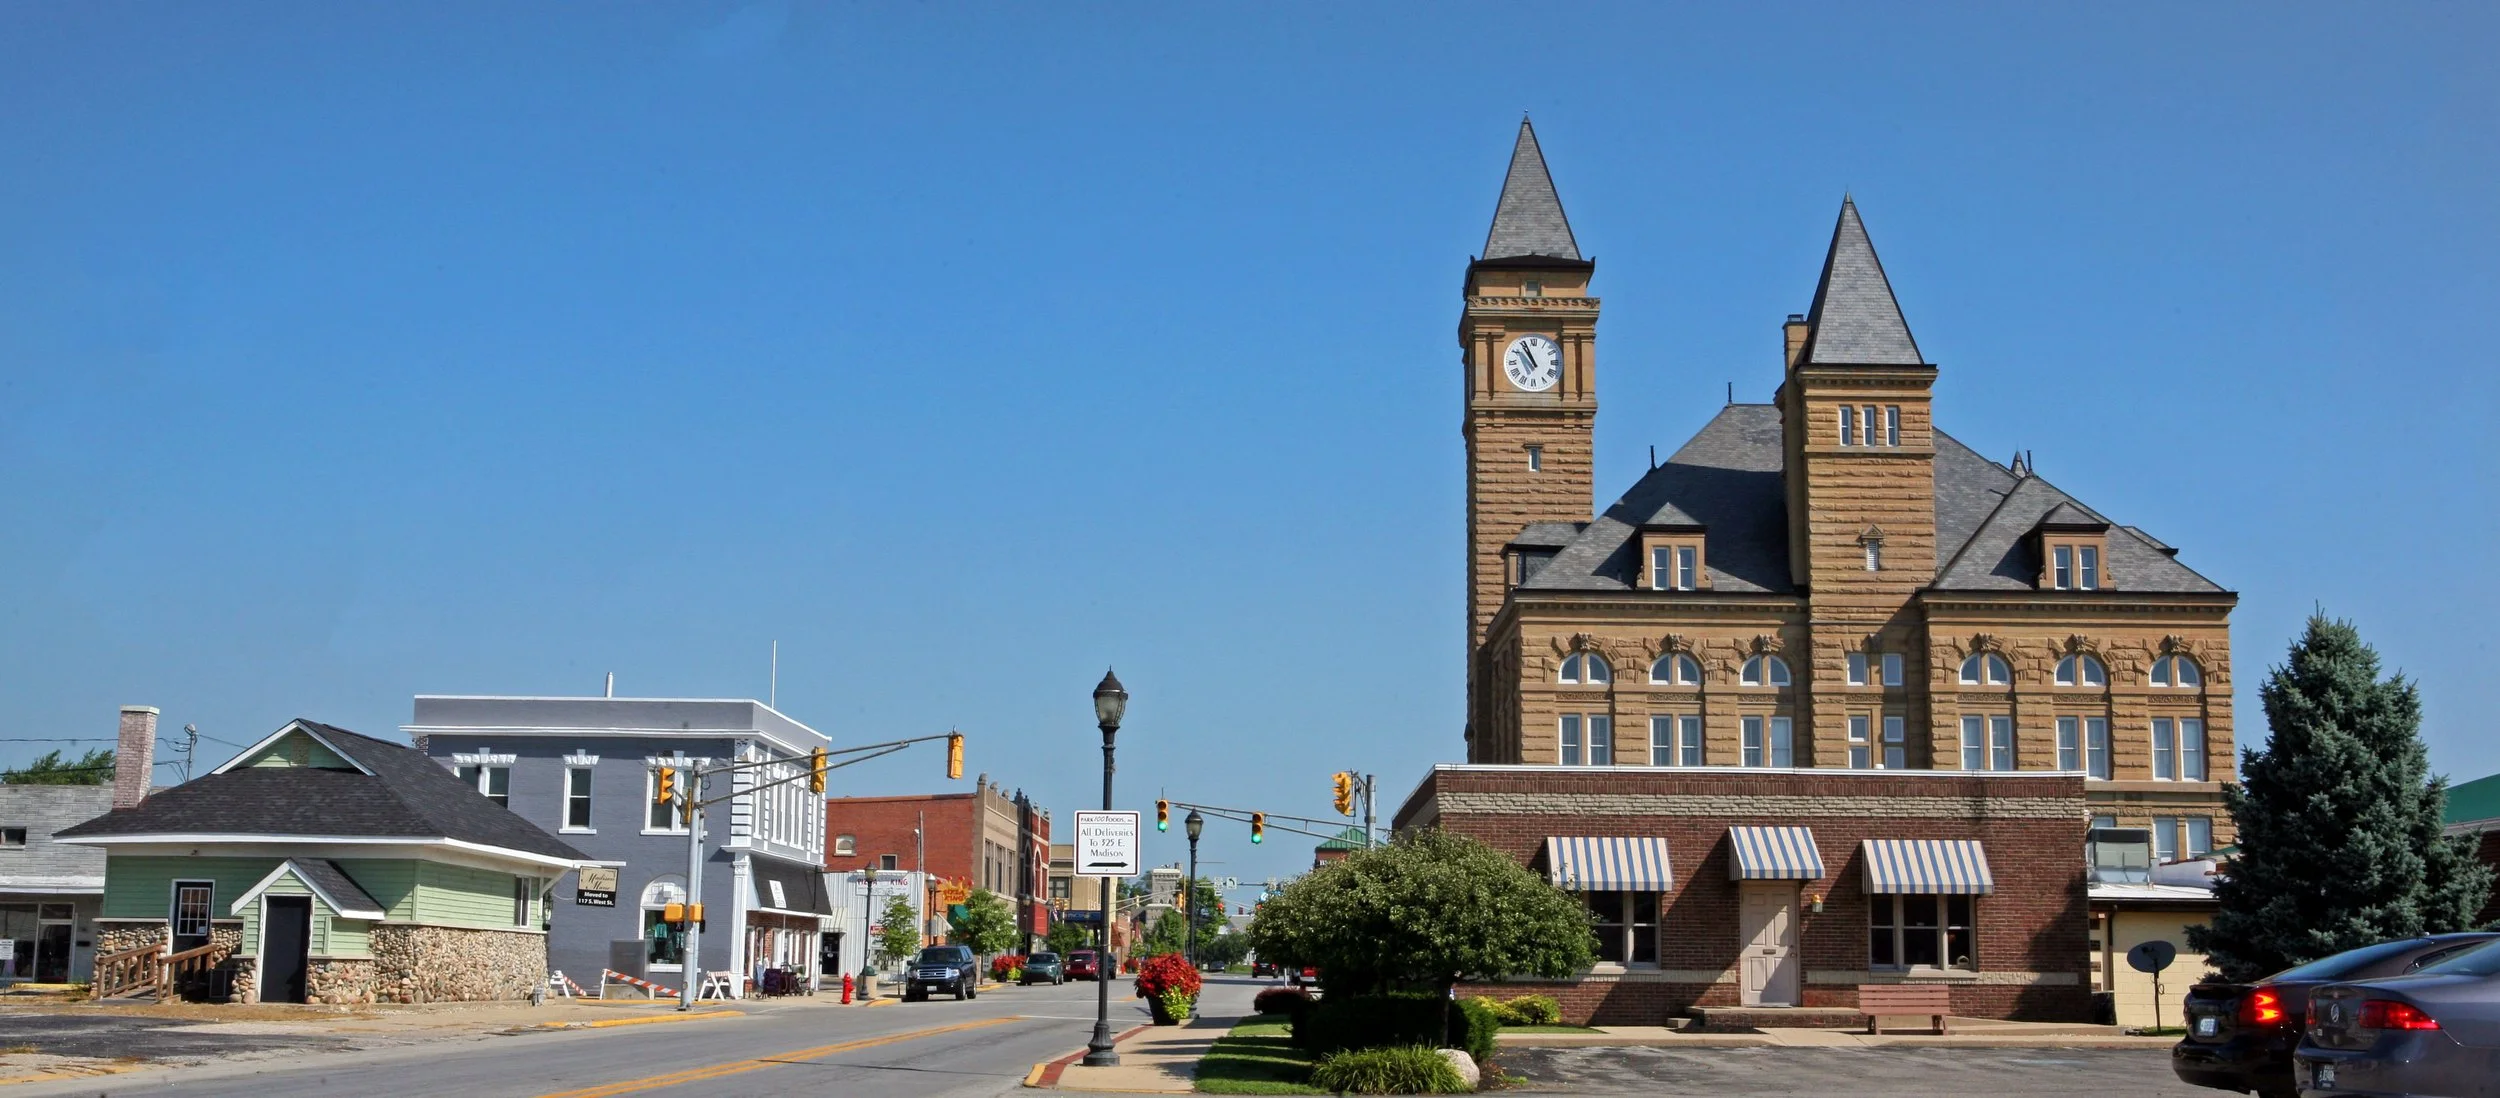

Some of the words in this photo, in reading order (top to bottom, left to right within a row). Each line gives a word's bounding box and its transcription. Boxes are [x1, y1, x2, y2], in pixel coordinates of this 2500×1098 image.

[1081, 828, 1092, 836] All
[1090, 839, 1099, 847] To
[1101, 838, 1115, 846] 325
[1118, 839, 1126, 847] E.
[1090, 849, 1124, 857] Madison
